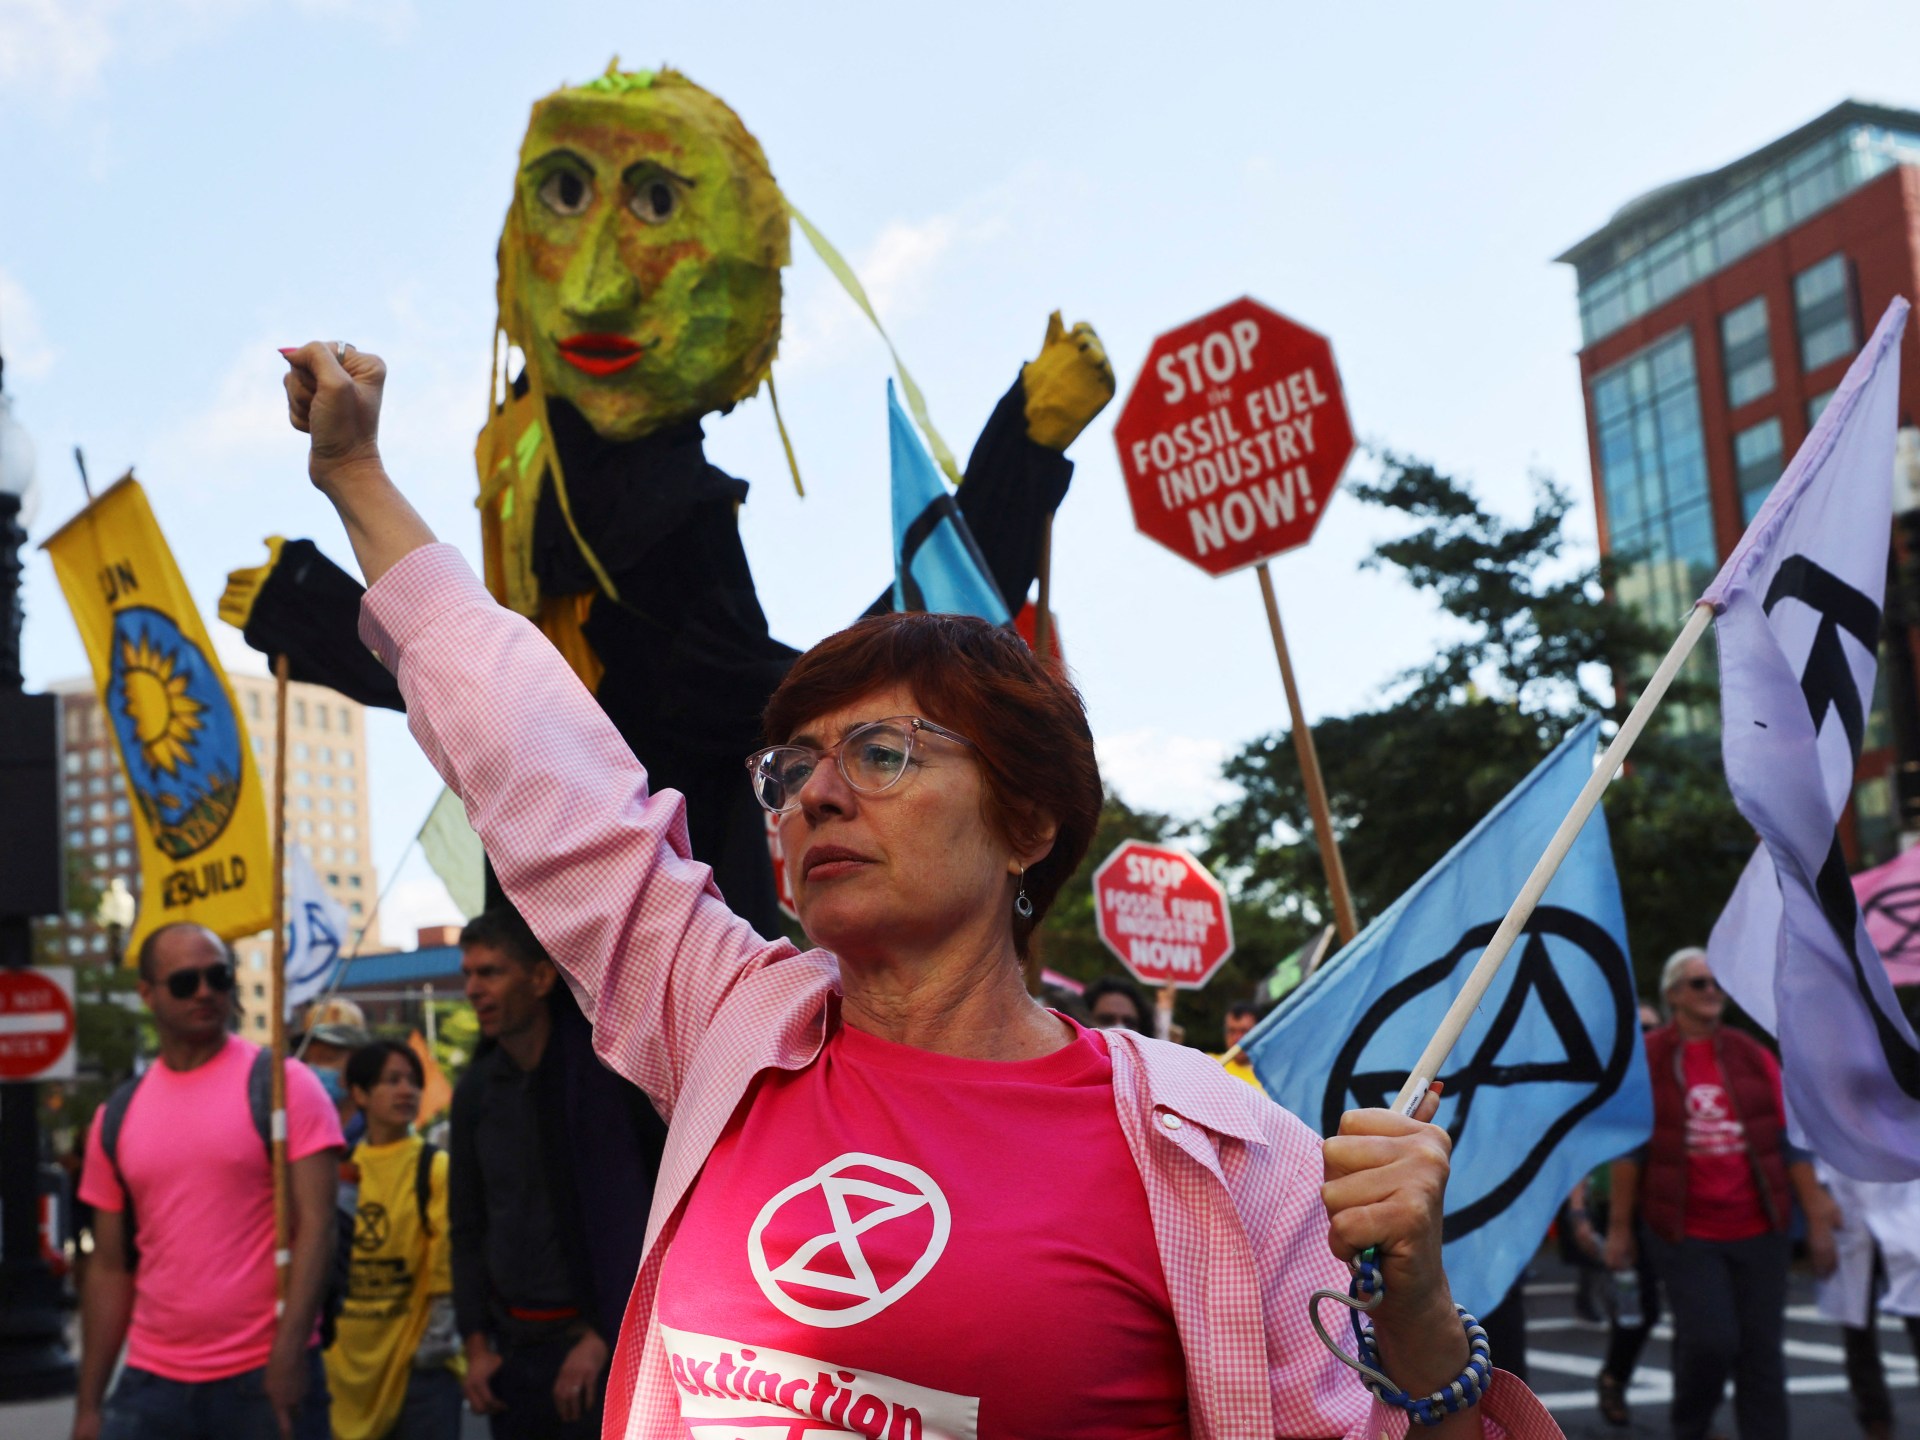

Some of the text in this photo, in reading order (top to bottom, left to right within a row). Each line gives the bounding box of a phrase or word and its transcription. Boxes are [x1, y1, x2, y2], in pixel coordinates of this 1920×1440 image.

[1156, 319, 1260, 404] STOP
[1131, 367, 1328, 476] FOSSIL FUEL
[1157, 412, 1317, 511] INDUSTRY
[1186, 465, 1318, 557] NOW!
[1125, 854, 1188, 890] STOP
[1129, 939, 1203, 974] NOW!
[672, 1349, 922, 1440] extinction
